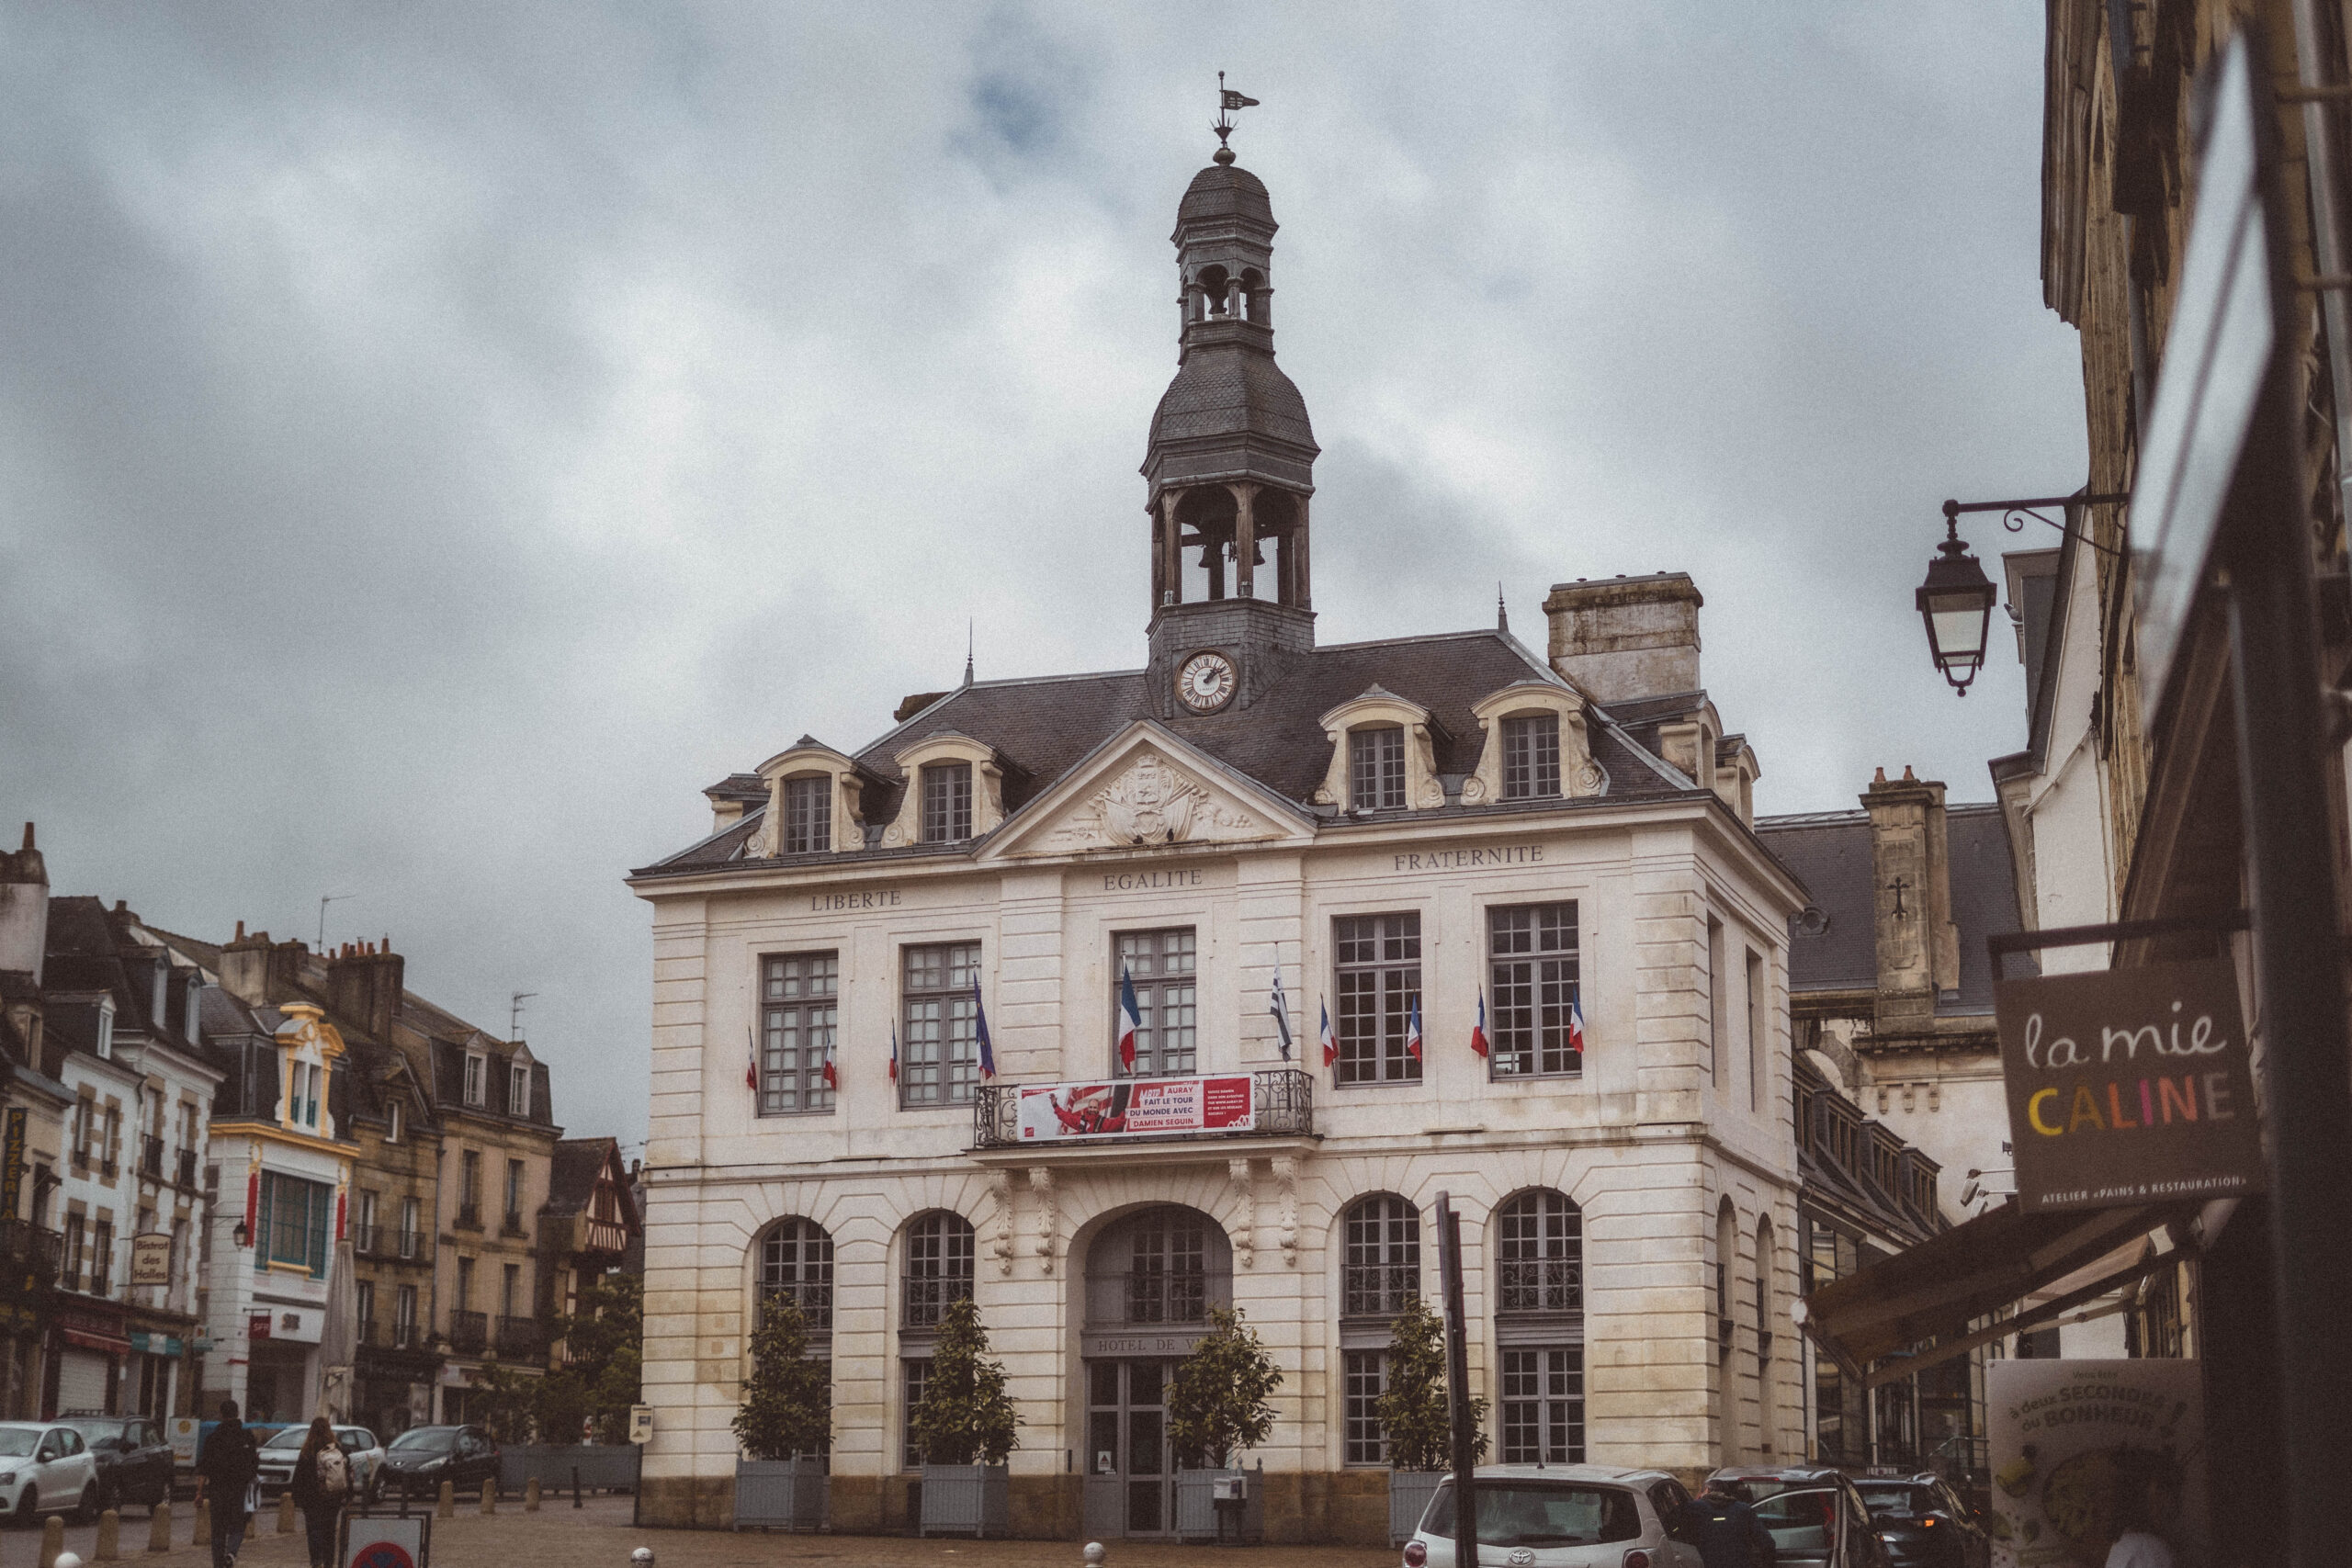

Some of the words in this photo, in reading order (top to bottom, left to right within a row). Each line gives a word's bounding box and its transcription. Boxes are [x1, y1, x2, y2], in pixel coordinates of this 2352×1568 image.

[1395, 844, 1544, 871] FRATERNITE
[1102, 868, 1203, 891] EGALITE
[811, 889, 902, 912] LIBERTE
[2025, 1012, 2090, 1069] la
[2101, 999, 2228, 1063] mie
[1167, 1086, 1194, 1095] AURAY
[1162, 1097, 1171, 1105] LE
[1172, 1096, 1194, 1104] TOUR
[1142, 1108, 1171, 1116] MONDE
[1172, 1106, 1194, 1114] AVEC
[1165, 1117, 1194, 1126] SEGUIN
[1, 1111, 24, 1221] PIZZERIA
[2041, 1190, 2088, 1204] ATELIER
[2139, 1184, 2147, 1194] &
[136, 1240, 170, 1251] Bistrot
[141, 1253, 161, 1265] des
[133, 1268, 167, 1280] Halles
[1098, 1339, 1147, 1351] HOTEL
[1157, 1338, 1175, 1350] DE
